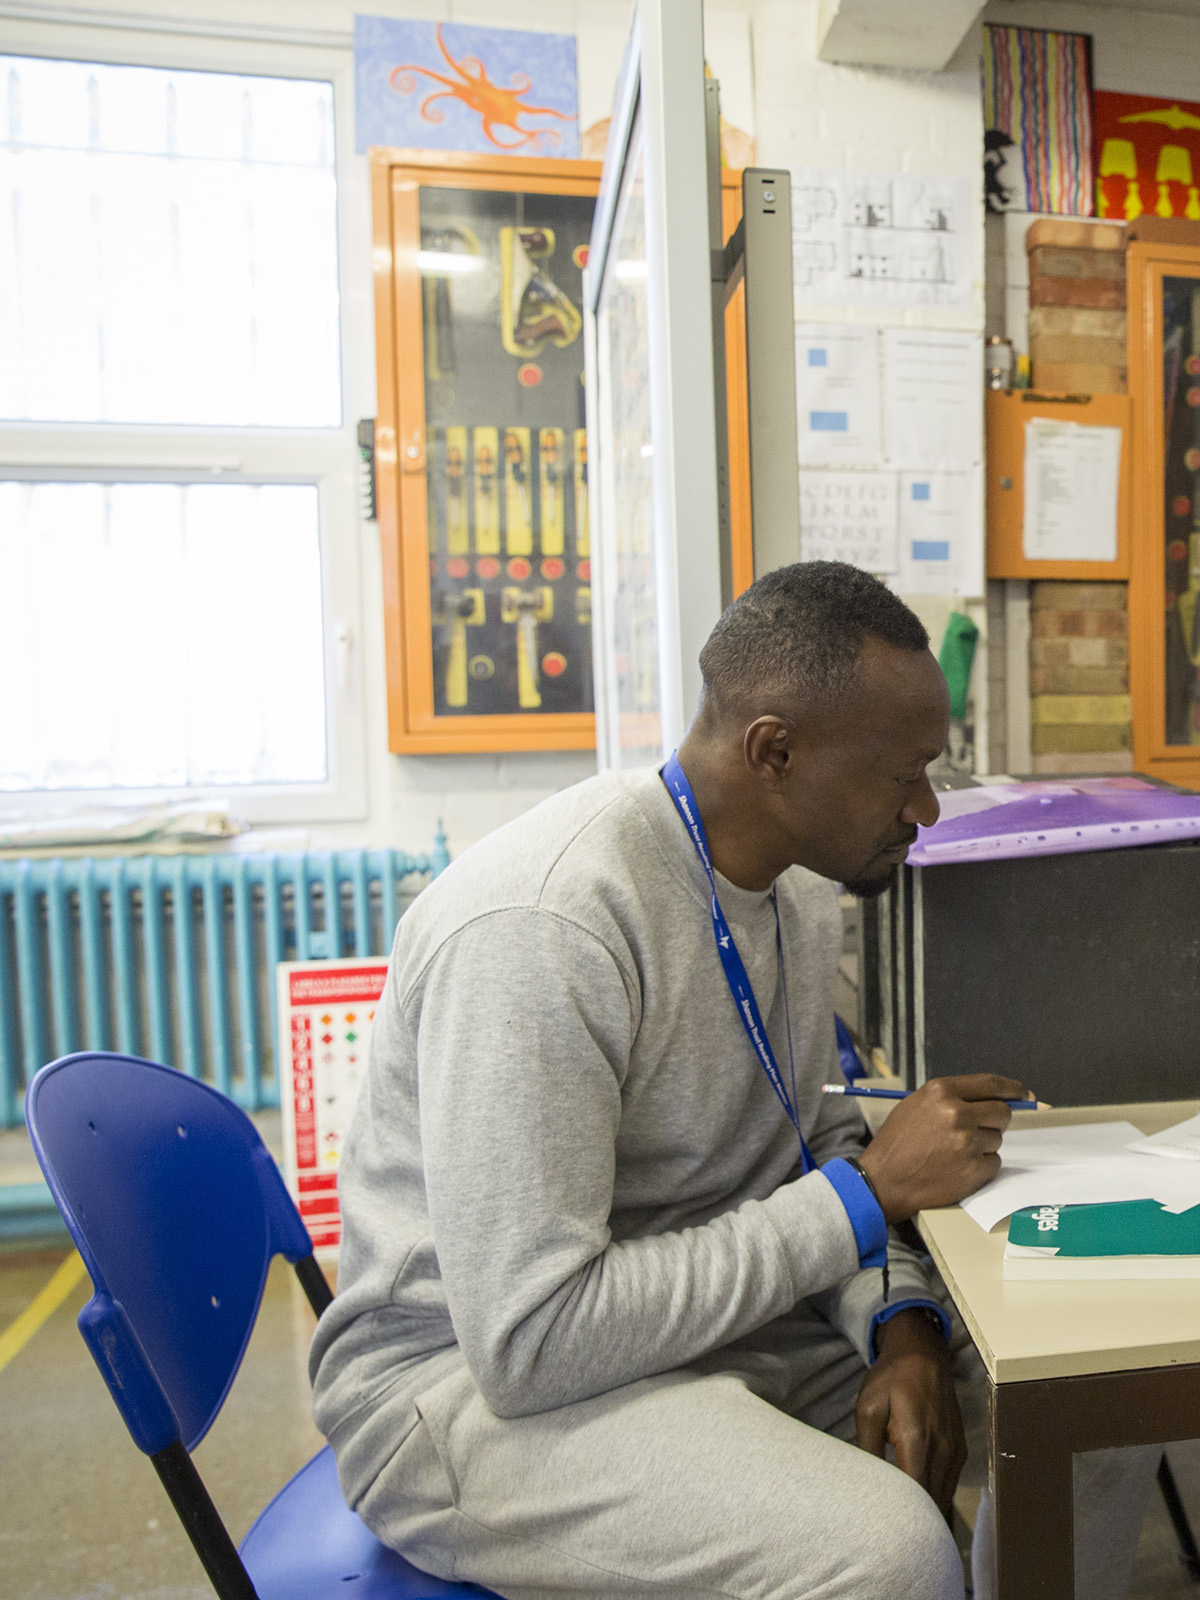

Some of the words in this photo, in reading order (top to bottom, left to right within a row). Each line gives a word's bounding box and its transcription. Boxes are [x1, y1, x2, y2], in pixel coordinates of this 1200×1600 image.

[677, 794, 695, 826] Shannon
[690, 823, 701, 843] Trust
[697, 841, 712, 870] Reading
[740, 997, 756, 1028] Shannon
[750, 1025, 762, 1043] Trust
[757, 1042, 773, 1070] Reading
